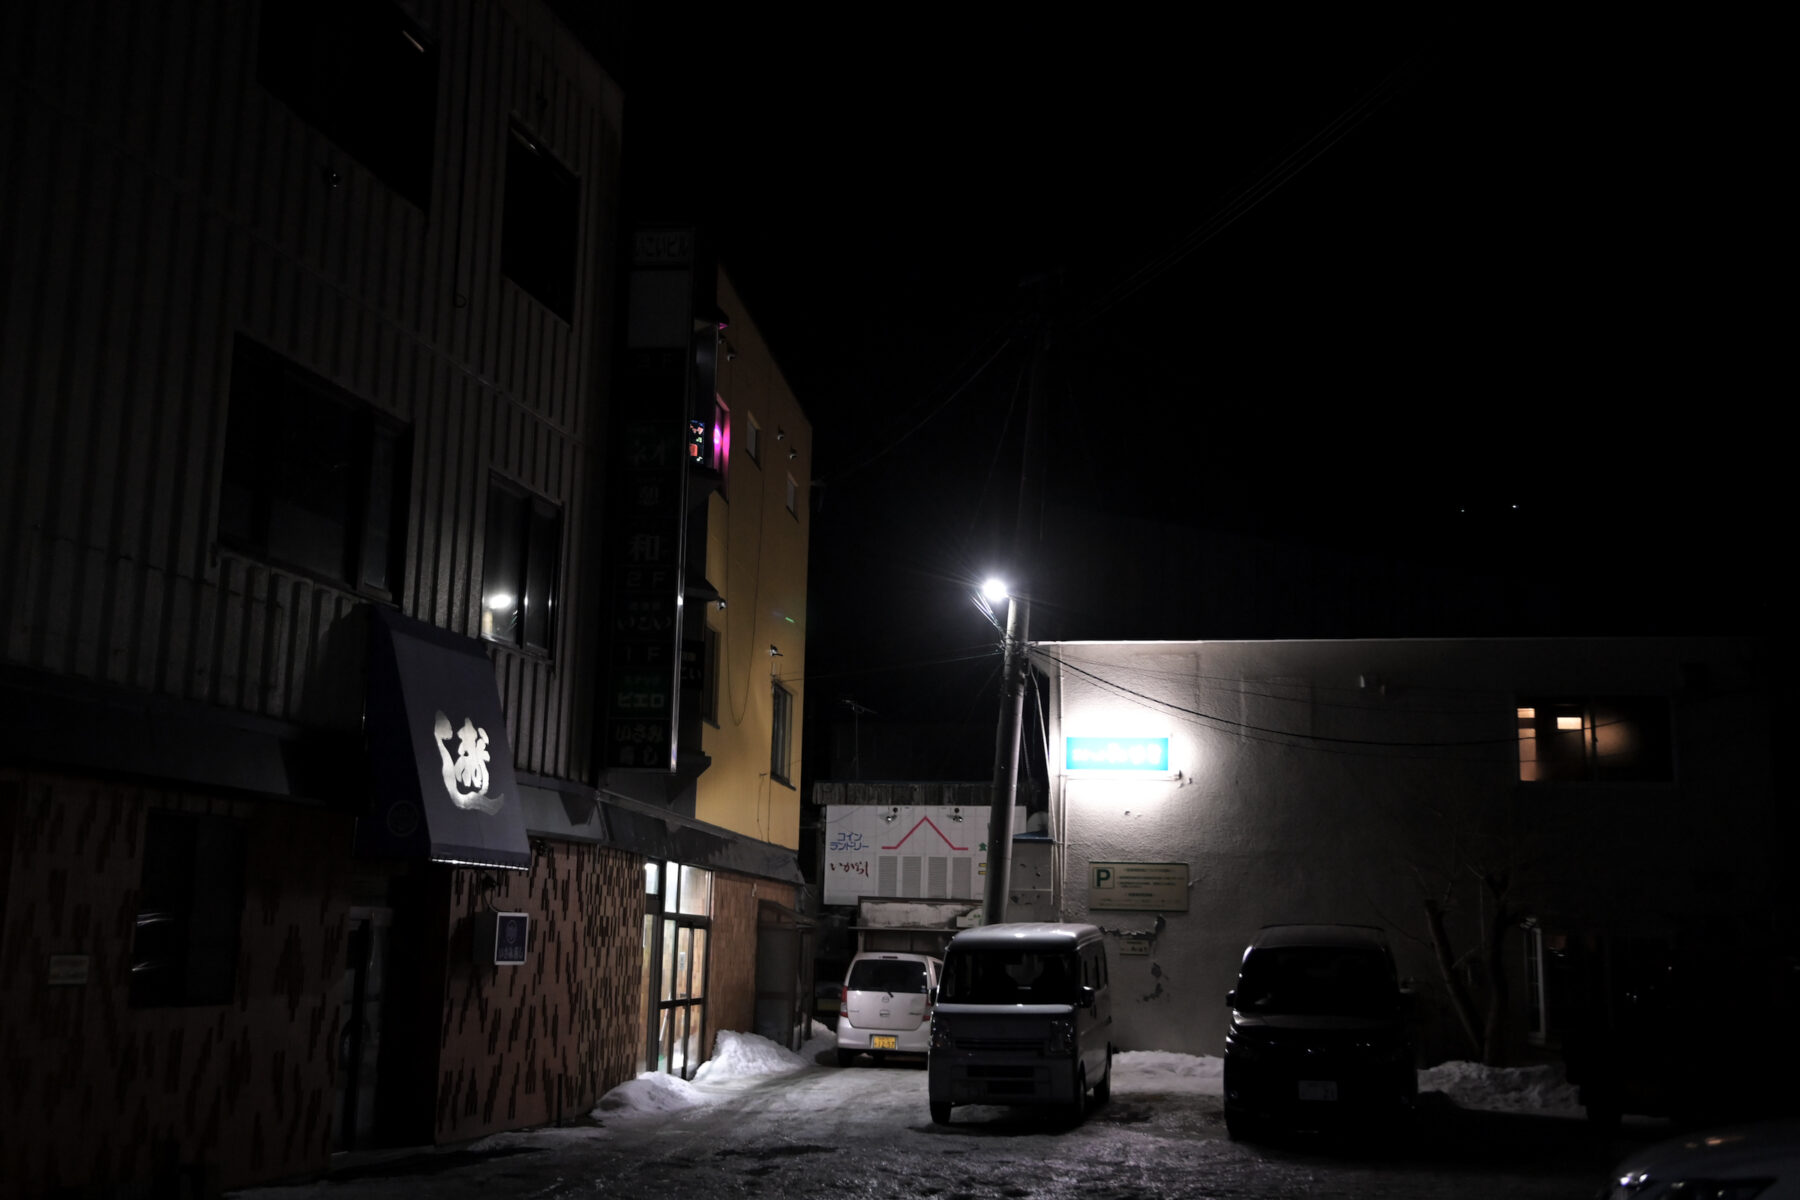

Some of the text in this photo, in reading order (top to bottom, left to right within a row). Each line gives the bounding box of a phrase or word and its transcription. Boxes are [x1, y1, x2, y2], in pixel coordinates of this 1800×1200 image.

[837, 831, 863, 842] コイン
[829, 841, 870, 851] ランドリー
[829, 860, 870, 878] いがらし
[1096, 868, 1111, 888] P
